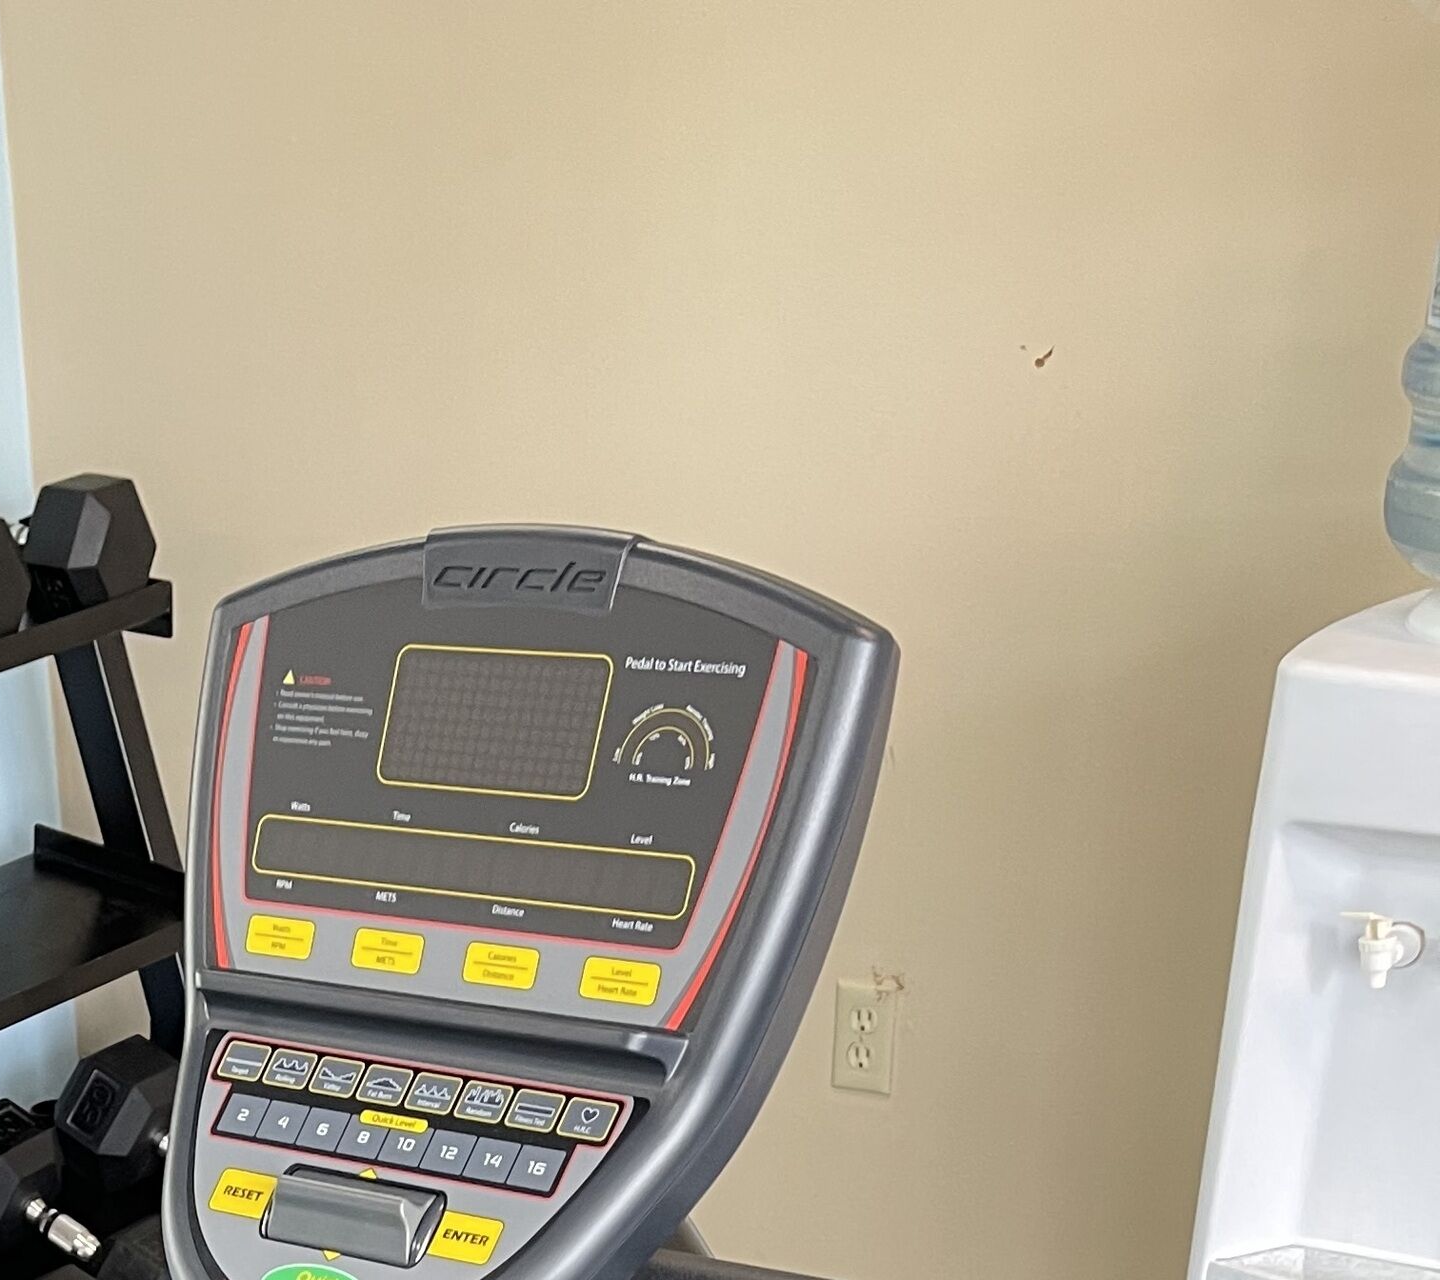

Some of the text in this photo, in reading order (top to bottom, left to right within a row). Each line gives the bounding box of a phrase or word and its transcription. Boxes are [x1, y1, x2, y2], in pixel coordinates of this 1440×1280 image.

[433, 561, 607, 592] circle
[625, 656, 747, 678] Pedal to Start Exercising
[291, 801, 311, 812] Watts
[392, 810, 411, 822] Time
[509, 822, 540, 835] Calories
[630, 833, 654, 846] Level
[276, 879, 293, 890] RPM
[376, 891, 397, 903] METS
[492, 904, 525, 917] Distance
[612, 917, 654, 932] Heart Rate
[611, 966, 633, 978] Level
[597, 984, 619, 995] Heart
[237, 1108, 250, 1121] 2
[371, 1113, 417, 1129] Quick Level
[277, 1115, 290, 1128] 4
[316, 1123, 330, 1136] 6
[357, 1130, 370, 1144] 8
[397, 1137, 416, 1151] 10
[440, 1145, 459, 1160] 12
[483, 1152, 503, 1168] 14
[527, 1160, 548, 1176] 16
[223, 1185, 264, 1202] RESET
[442, 1228, 490, 1247] ENTER
